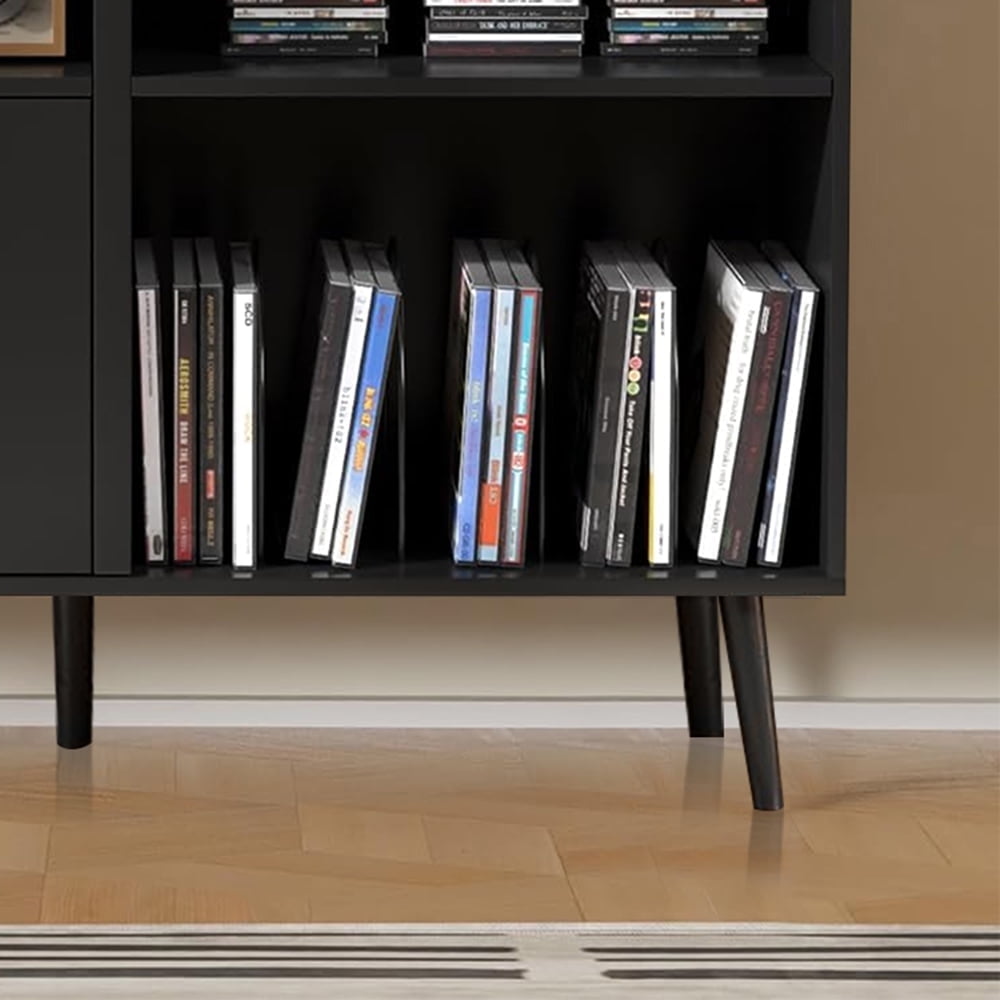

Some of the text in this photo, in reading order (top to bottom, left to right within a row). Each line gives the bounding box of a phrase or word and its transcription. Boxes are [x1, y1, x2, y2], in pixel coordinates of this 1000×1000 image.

[627, 399, 636, 416] Take
[179, 357, 189, 482] AEROSMITH DRAW THE LINE
[621, 446, 630, 466] Pants
[617, 483, 626, 506] Jacket
